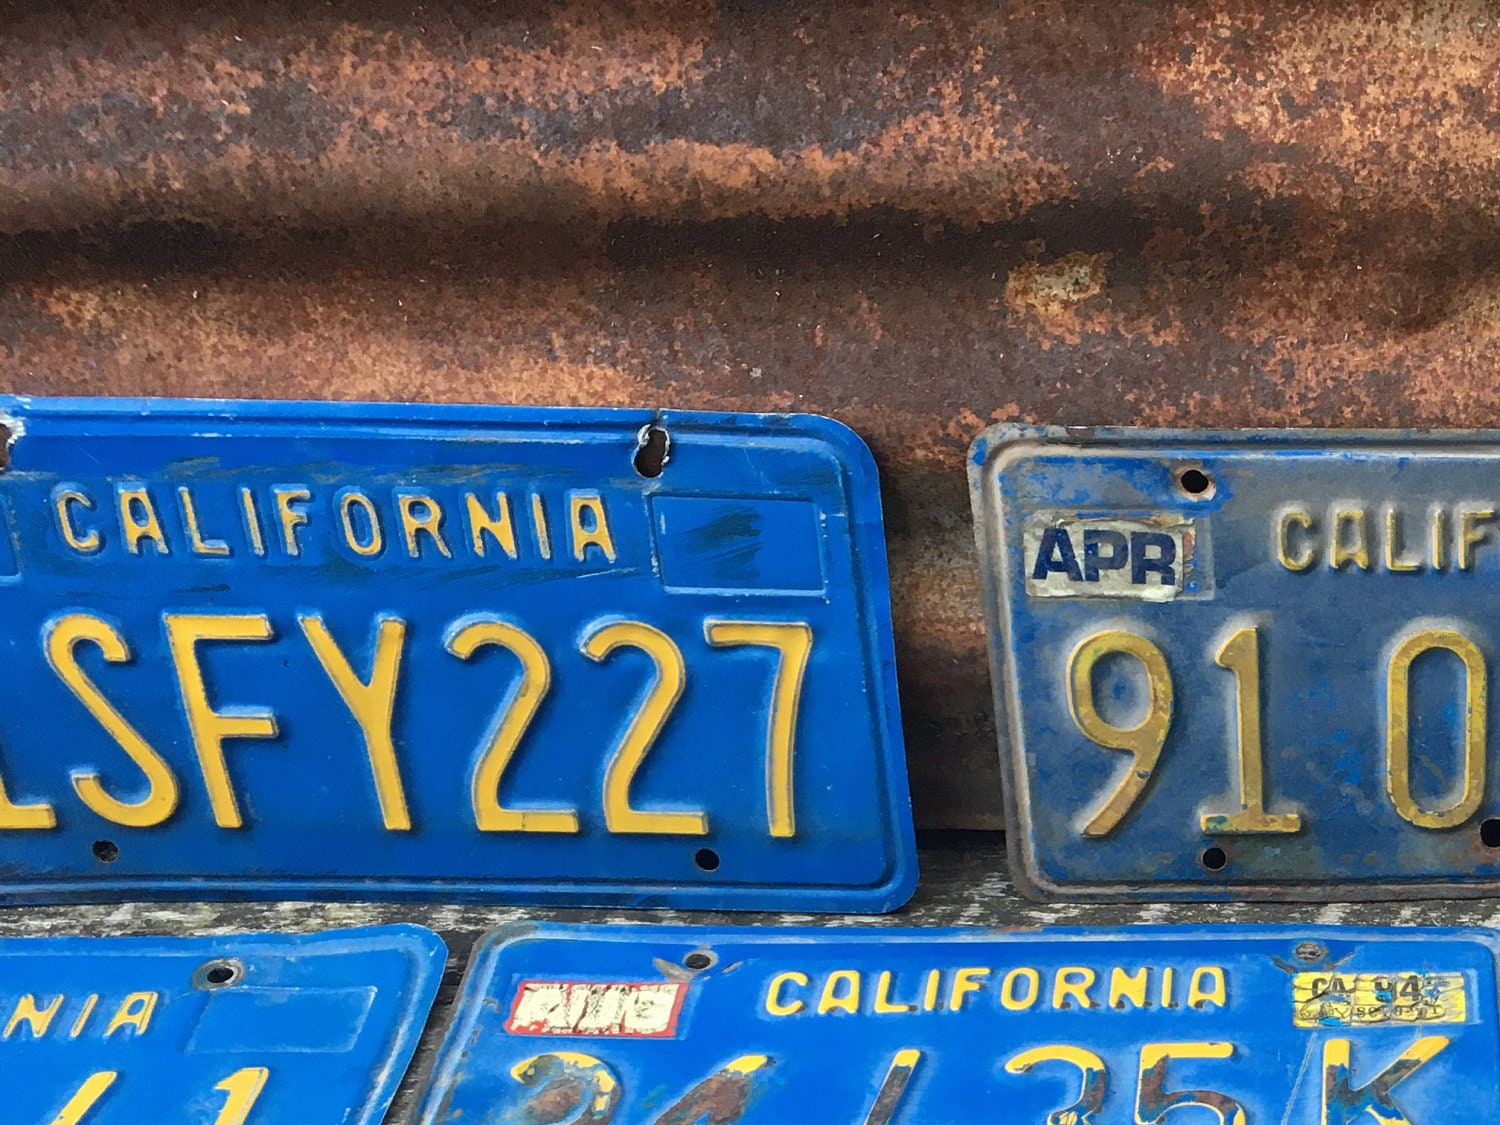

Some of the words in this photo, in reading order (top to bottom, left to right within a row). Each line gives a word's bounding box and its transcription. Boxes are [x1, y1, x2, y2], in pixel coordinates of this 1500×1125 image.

[54, 487, 618, 563] CALIFORNIA
[1032, 527, 1177, 585] APR
[0, 612, 814, 838] SFY227
[1066, 621, 1303, 839] 91
[765, 964, 1229, 1018] CALIFORNIA
